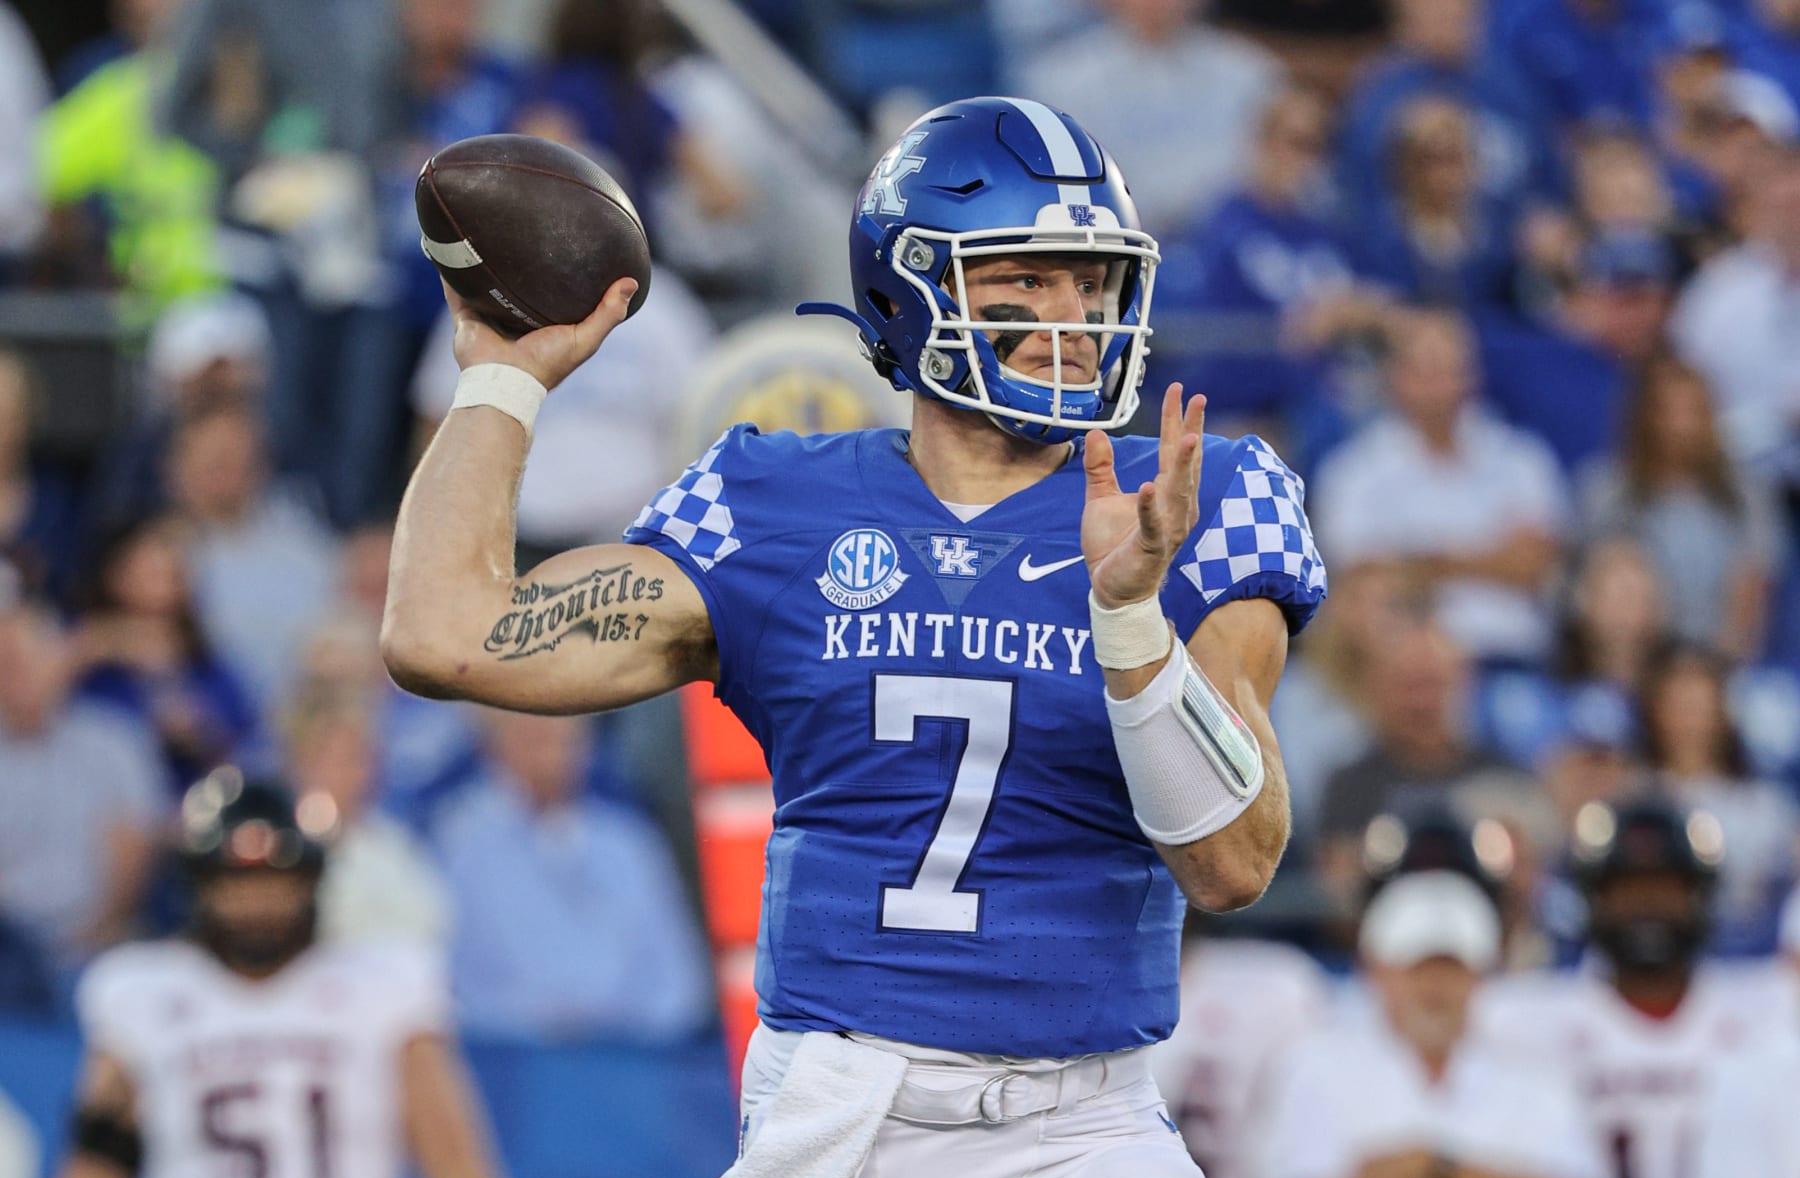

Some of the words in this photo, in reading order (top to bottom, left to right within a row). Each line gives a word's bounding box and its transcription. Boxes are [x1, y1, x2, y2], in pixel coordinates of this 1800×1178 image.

[1050, 404, 1084, 415] ddell
[835, 533, 891, 588] SEC
[927, 533, 983, 579] UK
[483, 569, 664, 653] Chronicles
[511, 581, 540, 605] 2nd
[825, 582, 896, 609] GRADUATE
[600, 612, 649, 642] 15:7
[821, 611, 1092, 674] KENTUCKY
[871, 671, 1016, 935] 7
